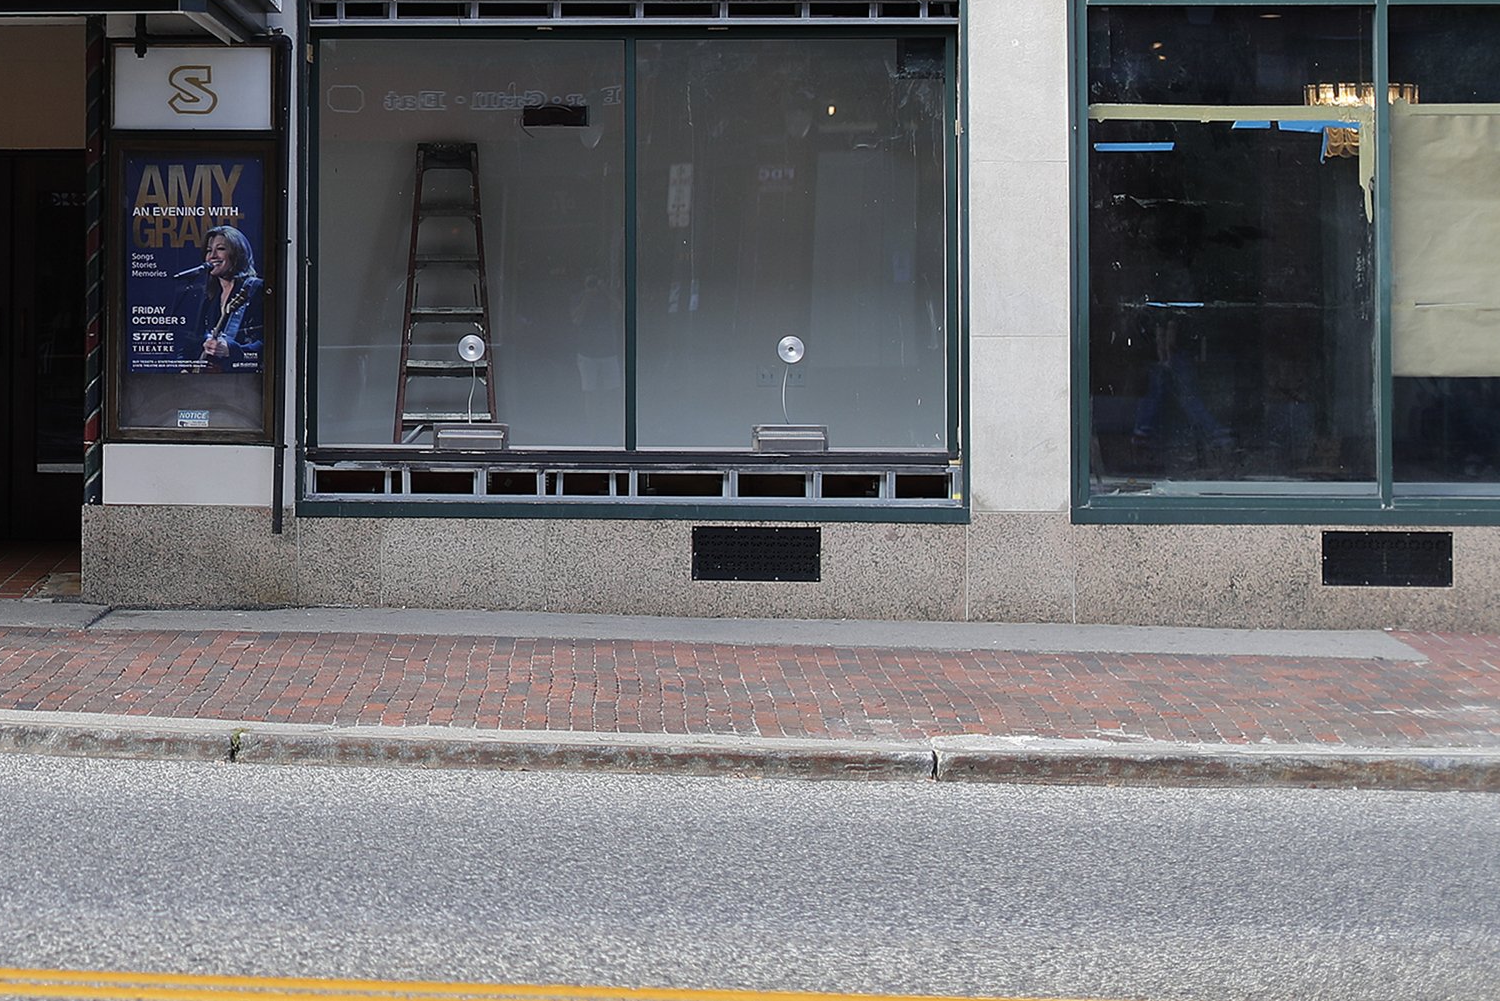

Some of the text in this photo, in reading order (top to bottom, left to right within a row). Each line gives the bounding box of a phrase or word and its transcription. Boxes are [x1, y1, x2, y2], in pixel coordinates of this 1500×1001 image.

[167, 65, 218, 115] S
[133, 164, 244, 209] AMY
[132, 206, 239, 217] AN EVENING WITH
[131, 253, 154, 261] Songs
[131, 261, 157, 269] Stories
[131, 270, 167, 278] Memories
[132, 306, 166, 315] FRIDAY
[132, 316, 186, 326] OCTOBER 3
[132, 332, 174, 341] STATE
